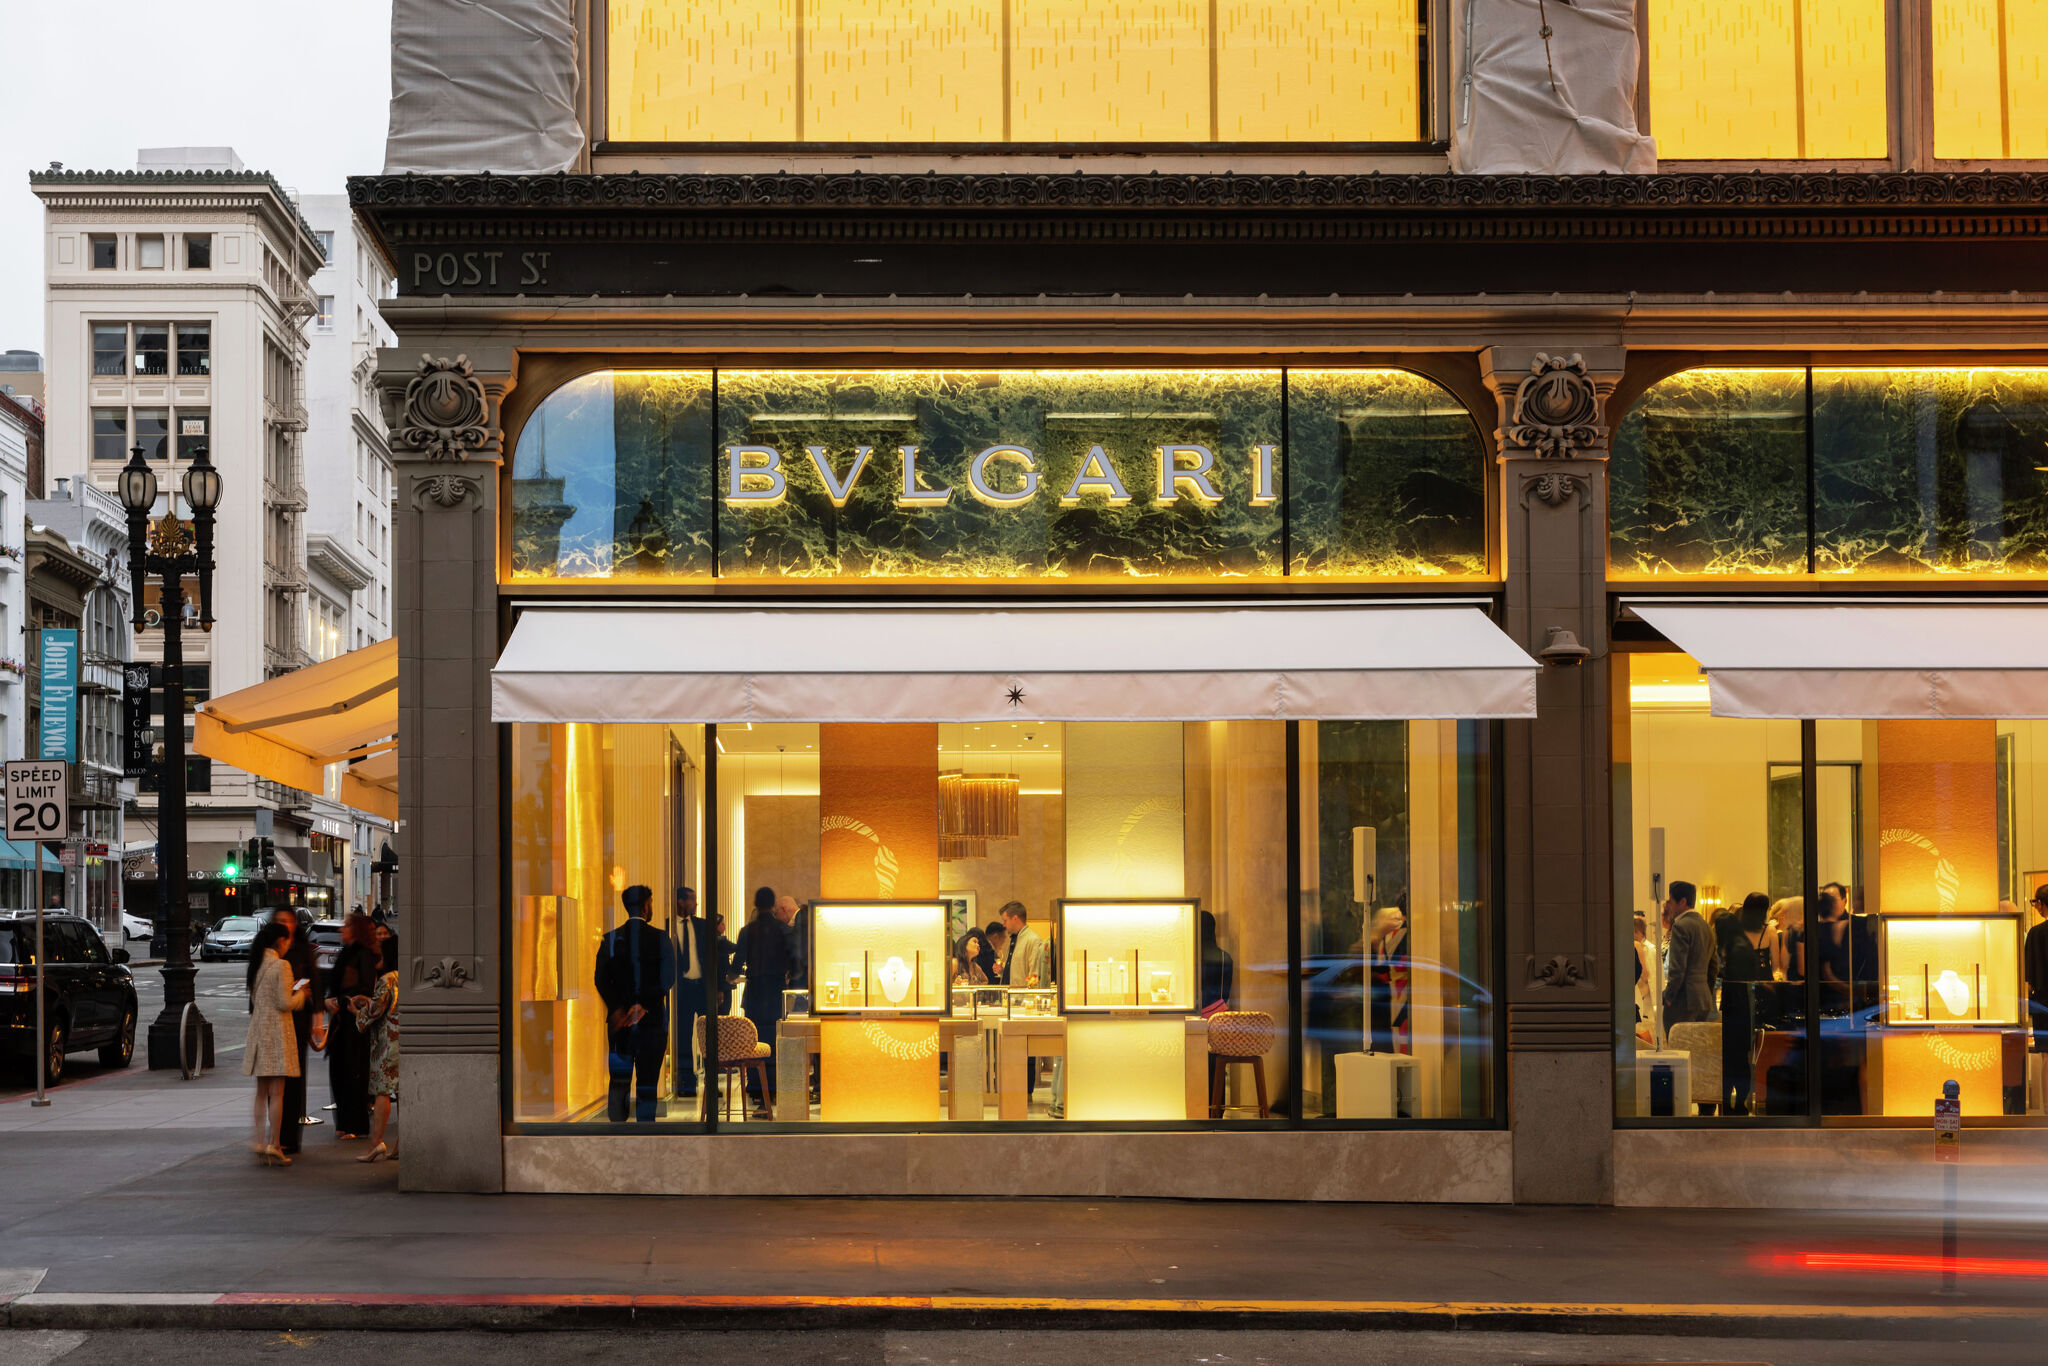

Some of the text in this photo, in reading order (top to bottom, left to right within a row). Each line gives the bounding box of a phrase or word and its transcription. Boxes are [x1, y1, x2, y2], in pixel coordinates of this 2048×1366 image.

[413, 252, 503, 287] POST
[180, 366, 207, 374] PASTEL
[724, 445, 1278, 508] BVLGARI
[43, 636, 74, 757] JOHN FLUEVOG
[132, 697, 142, 759] WICKED
[11, 769, 62, 782] SPEED
[16, 785, 56, 798] LIMIT
[13, 802, 61, 831] 20
